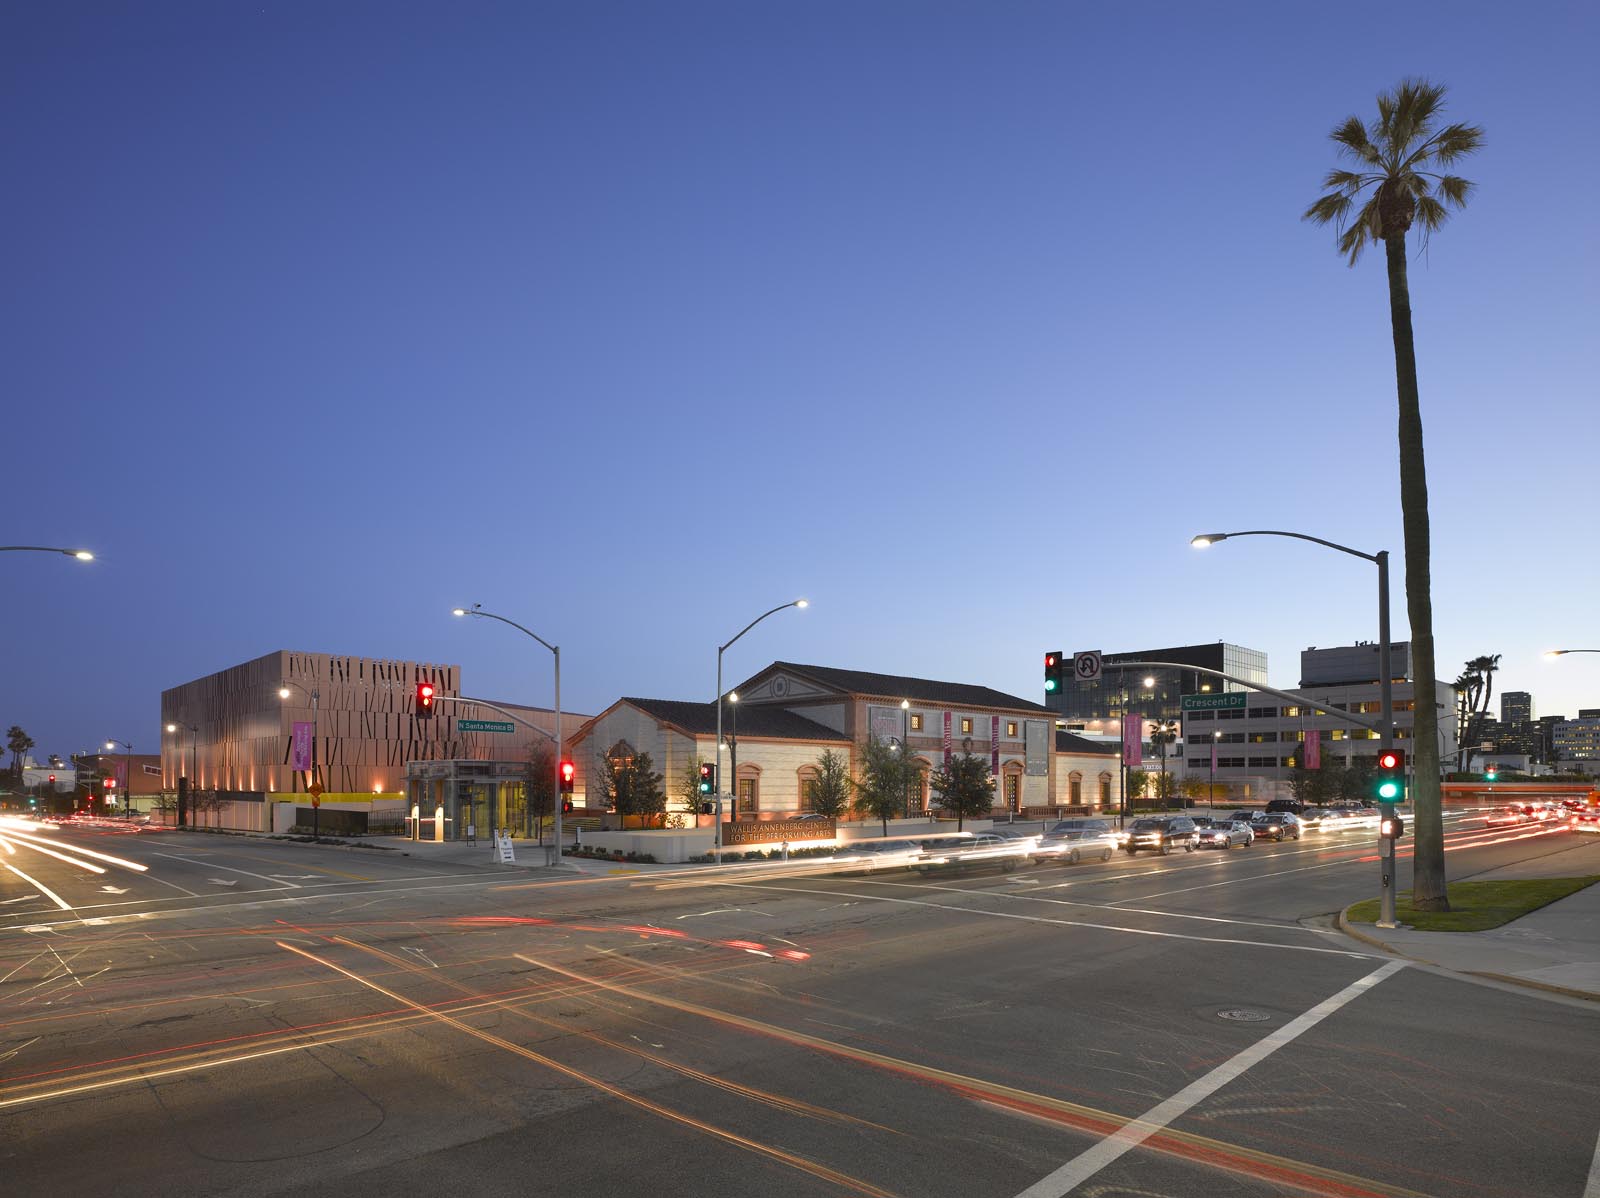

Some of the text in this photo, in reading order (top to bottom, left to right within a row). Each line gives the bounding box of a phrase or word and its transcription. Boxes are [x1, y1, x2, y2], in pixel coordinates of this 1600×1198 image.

[1184, 696, 1242, 707] Crescent Dr
[465, 722, 484, 730] Santa
[944, 720, 952, 749] Wallis
[730, 821, 831, 833] WALLIS ANNENBERG CENTER
[730, 834, 746, 842] FOR
[749, 833, 763, 841] THE
[766, 831, 813, 840] PERFORMING
